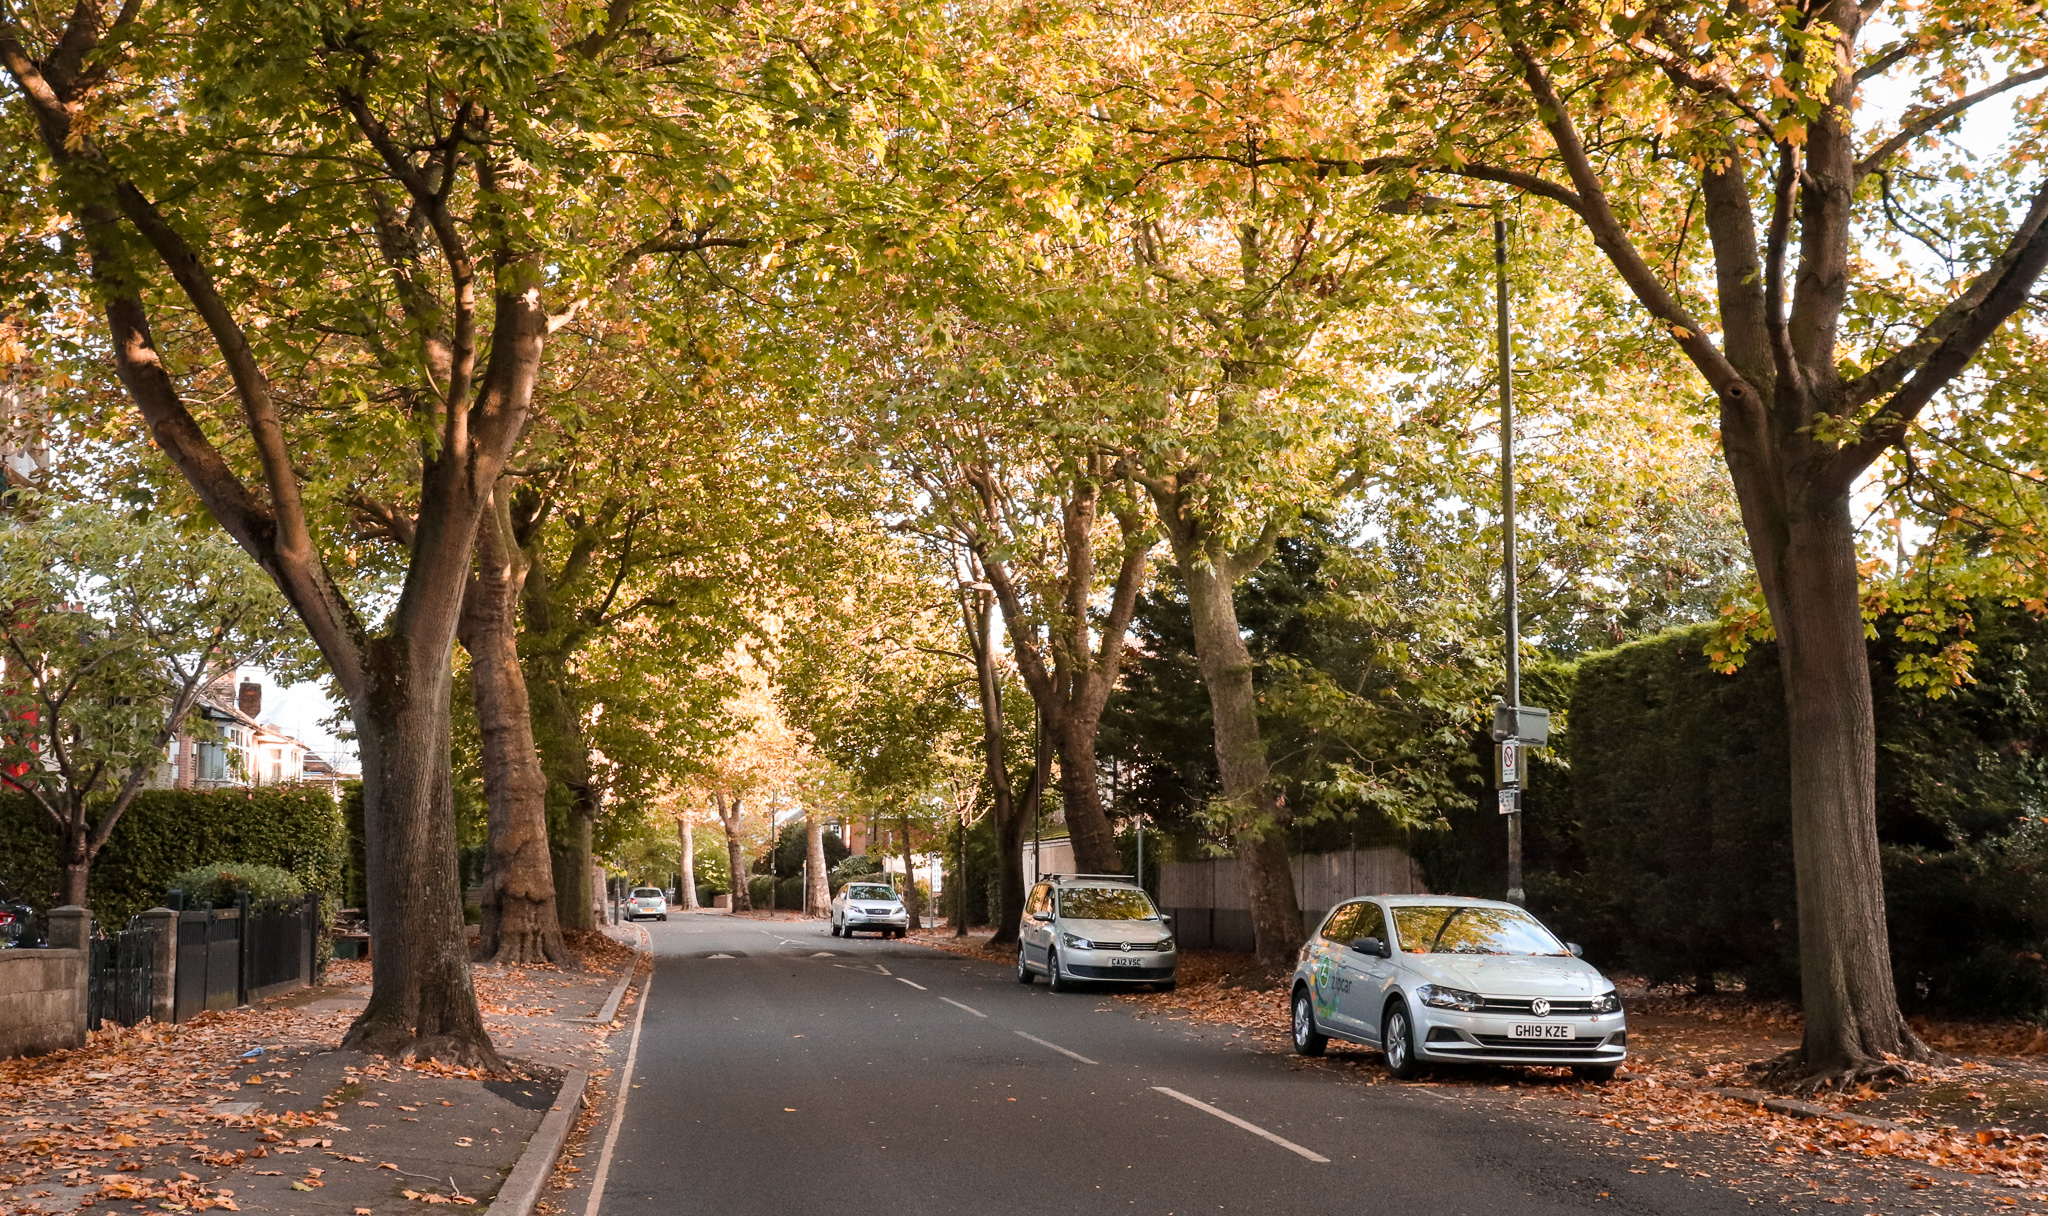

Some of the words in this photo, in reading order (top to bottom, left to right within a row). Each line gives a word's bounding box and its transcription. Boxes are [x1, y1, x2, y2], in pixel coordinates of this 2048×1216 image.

[1111, 958, 1127, 966] CA12
[1128, 958, 1141, 966] VSC
[1515, 1024, 1542, 1037] GH19
[1545, 1025, 1569, 1038] KZE
